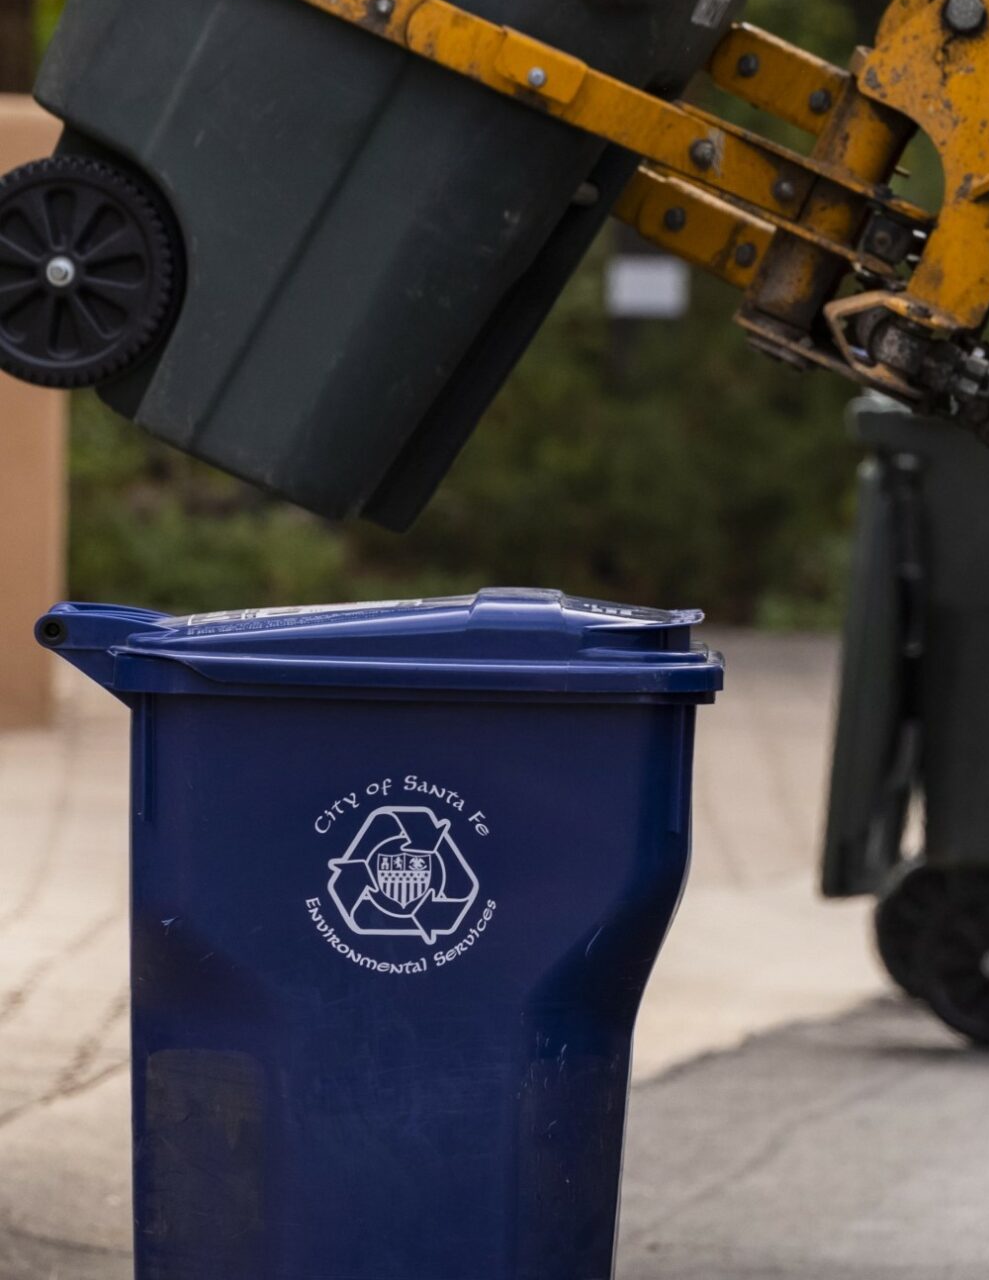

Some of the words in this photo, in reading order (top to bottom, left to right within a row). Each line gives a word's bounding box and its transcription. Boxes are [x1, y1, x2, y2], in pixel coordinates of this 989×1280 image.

[314, 793, 360, 834] City
[366, 778, 392, 796] of
[403, 775, 465, 811] Santa
[468, 811, 490, 837] Fe
[305, 897, 427, 974] Environmental
[433, 899, 497, 967] Services
